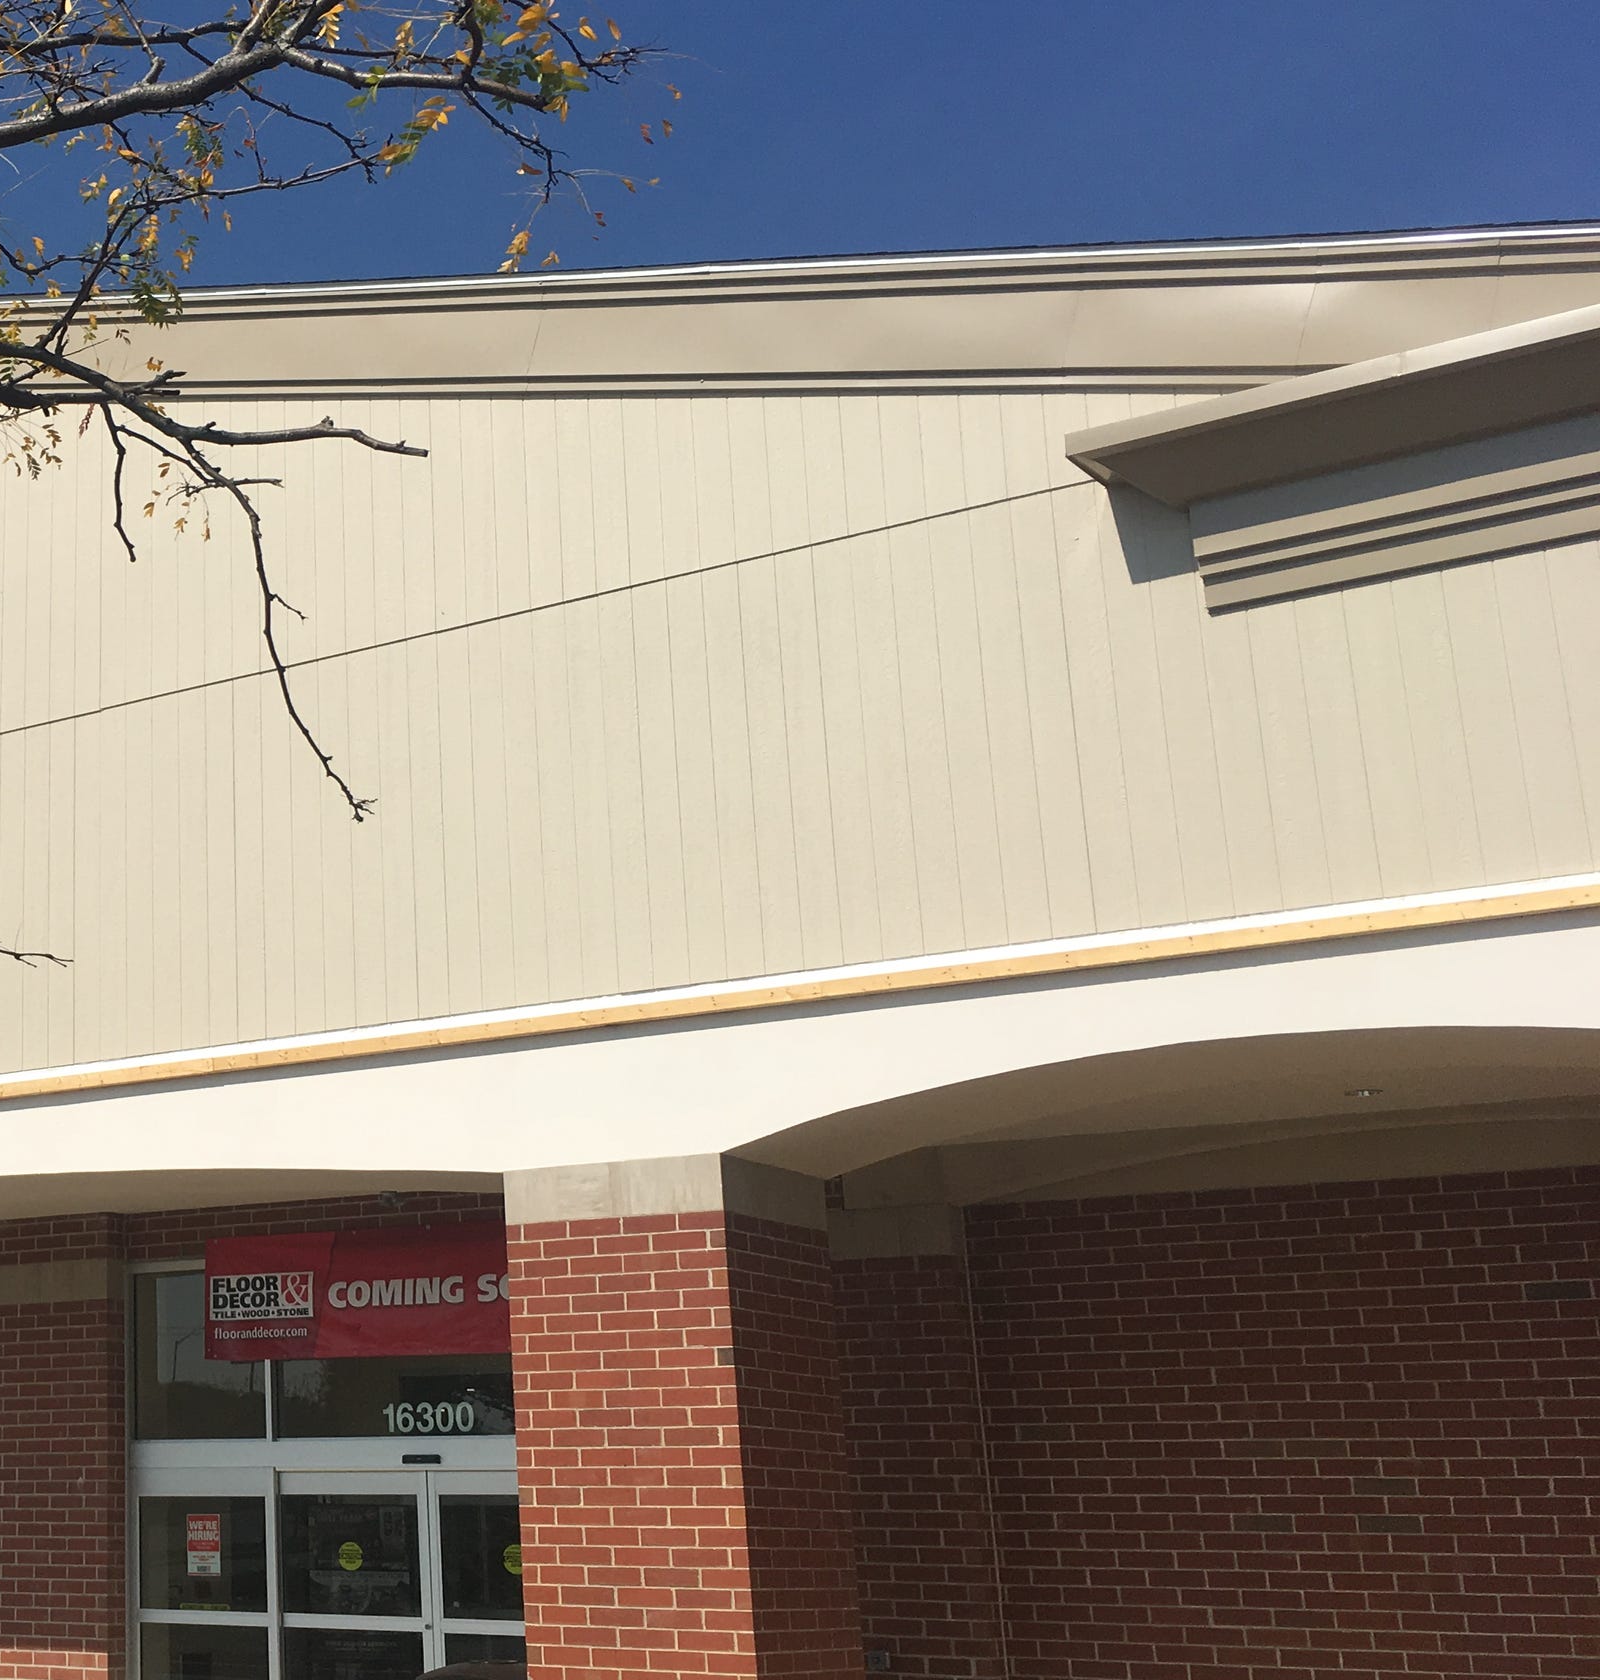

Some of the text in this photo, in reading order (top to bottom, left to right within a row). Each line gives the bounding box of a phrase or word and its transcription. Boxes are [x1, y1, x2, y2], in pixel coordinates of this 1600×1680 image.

[212, 1274, 308, 1306] FLOOR &
[328, 1274, 464, 1309] COMING
[212, 1292, 280, 1309] DECOR
[212, 1307, 310, 1319] TILE WOOD STONE
[214, 1326, 308, 1340] flooranddecor.com
[382, 1402, 474, 1433] 16300
[188, 1520, 218, 1530] WE'RE
[188, 1530, 219, 1541] HIRING
